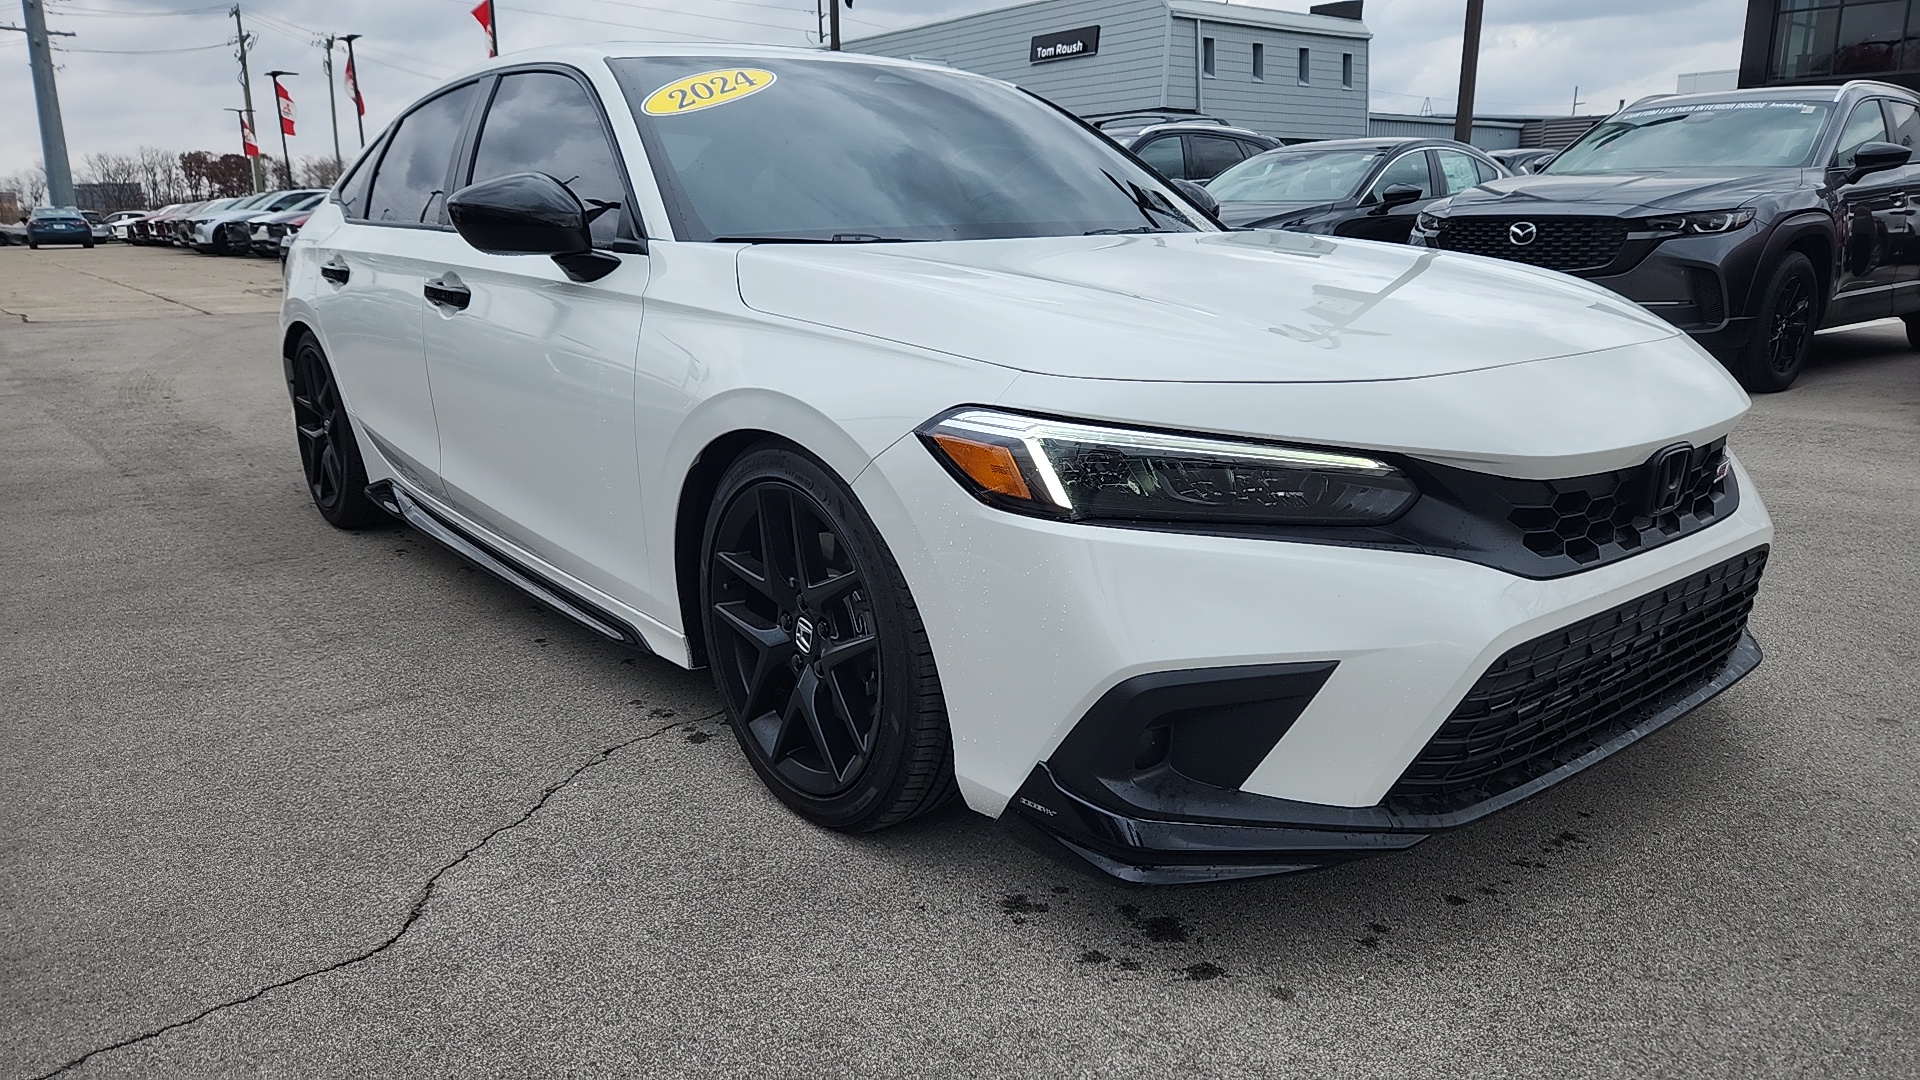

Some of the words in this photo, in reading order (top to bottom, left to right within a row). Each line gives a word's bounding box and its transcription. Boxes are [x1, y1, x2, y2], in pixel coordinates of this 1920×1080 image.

[1036, 46, 1055, 58] Tom
[1055, 40, 1083, 55] Roush
[667, 71, 758, 110] 2024
[1658, 105, 1696, 115] LEATHER
[1695, 103, 1737, 111] INTERIOR
